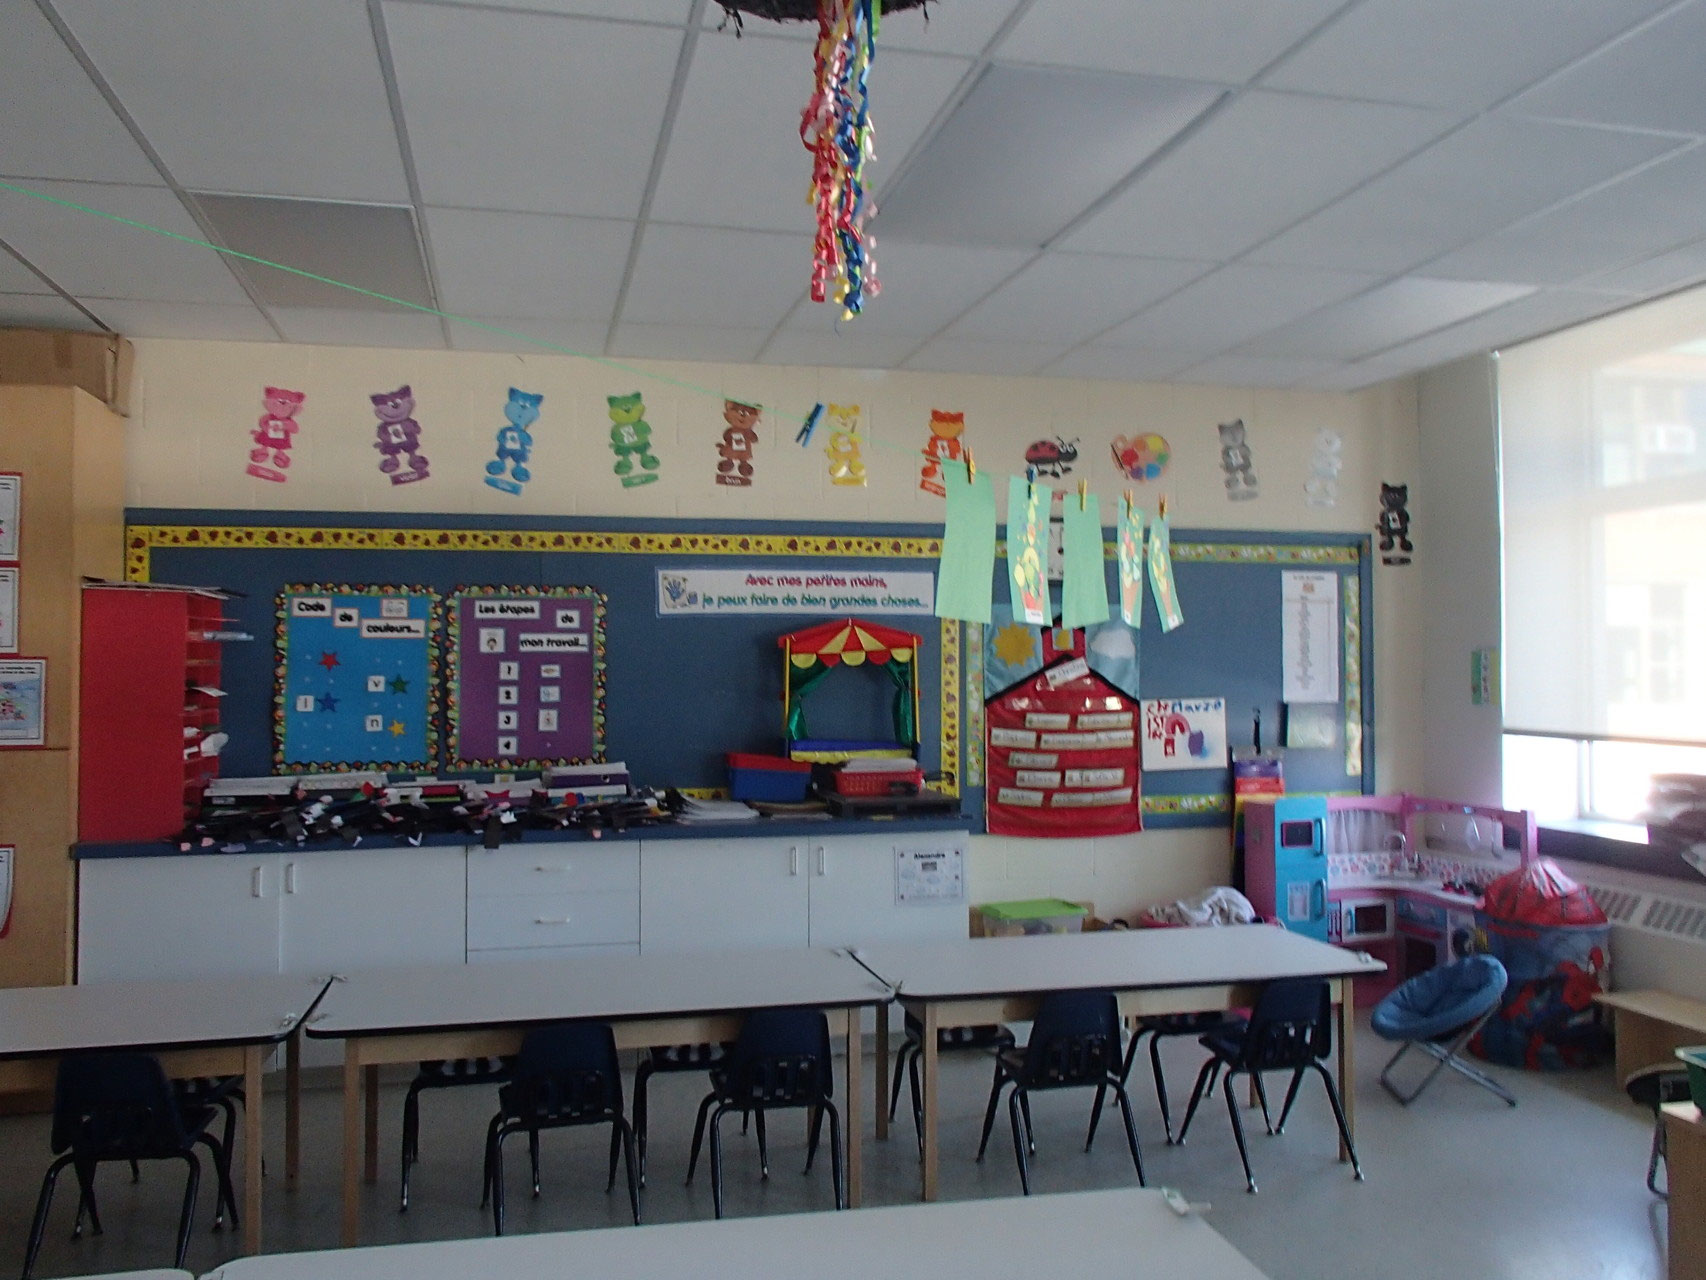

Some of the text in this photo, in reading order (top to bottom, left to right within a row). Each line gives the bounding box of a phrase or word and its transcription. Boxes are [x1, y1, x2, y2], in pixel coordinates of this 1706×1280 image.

[745, 574, 774, 586] Avec
[777, 576, 802, 586] mes
[806, 574, 847, 588] petites
[702, 592, 713, 609] je
[718, 595, 747, 609] peux
[751, 593, 778, 606] faire
[782, 593, 797, 606] de
[801, 593, 826, 606] bien
[829, 595, 878, 610] grandes
[298, 601, 353, 622] Code de
[479, 604, 496, 614] Les
[561, 614, 574, 624] de
[520, 638, 543, 648] mon
